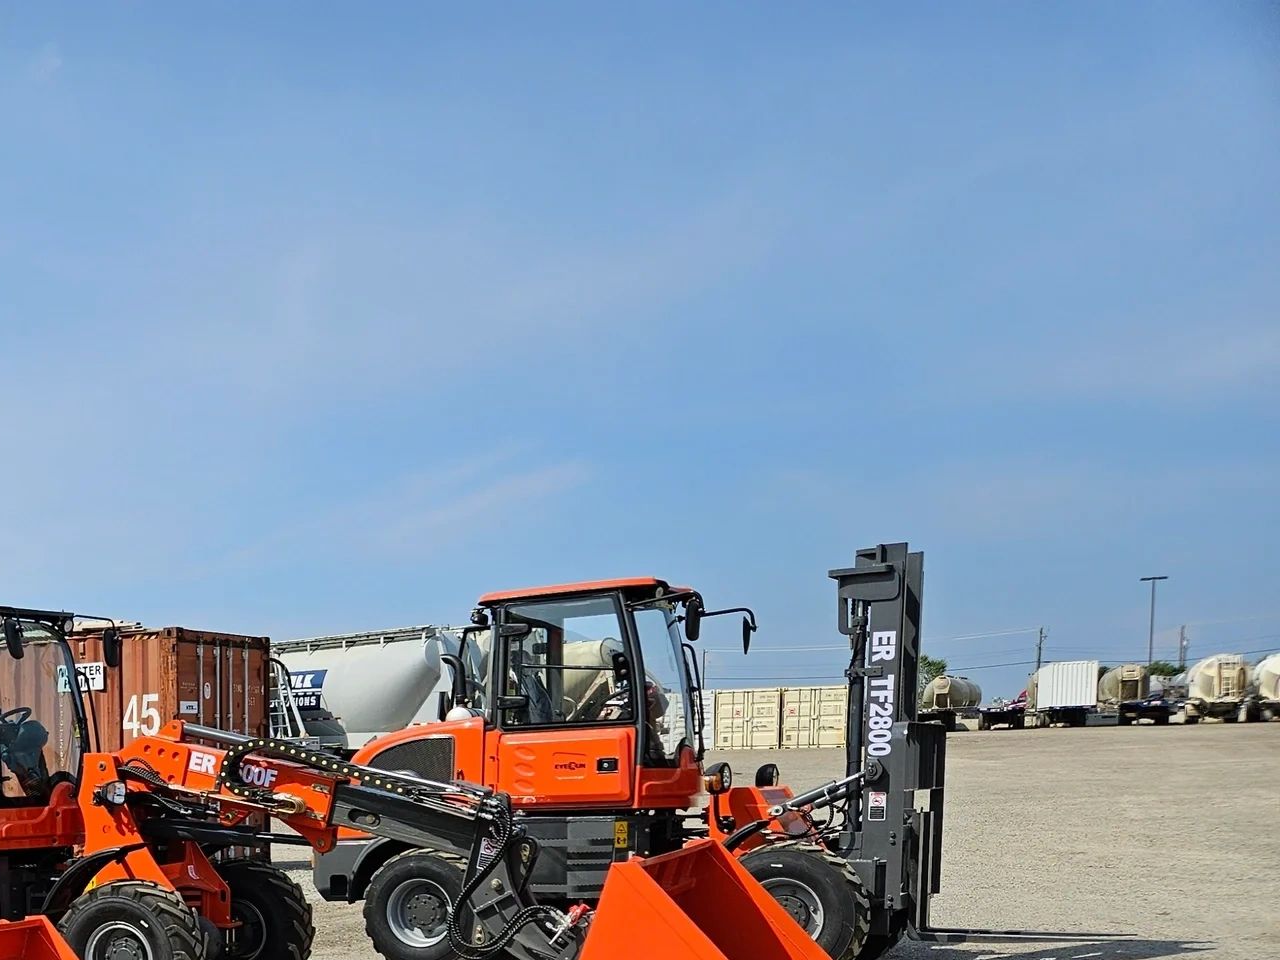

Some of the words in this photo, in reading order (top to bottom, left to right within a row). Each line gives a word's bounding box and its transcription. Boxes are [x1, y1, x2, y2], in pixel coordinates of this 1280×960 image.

[872, 631, 896, 662] ER
[58, 665, 101, 678] MSTER
[64, 677, 96, 689] PIT
[123, 693, 161, 738] 45
[868, 674, 895, 757] TF2800
